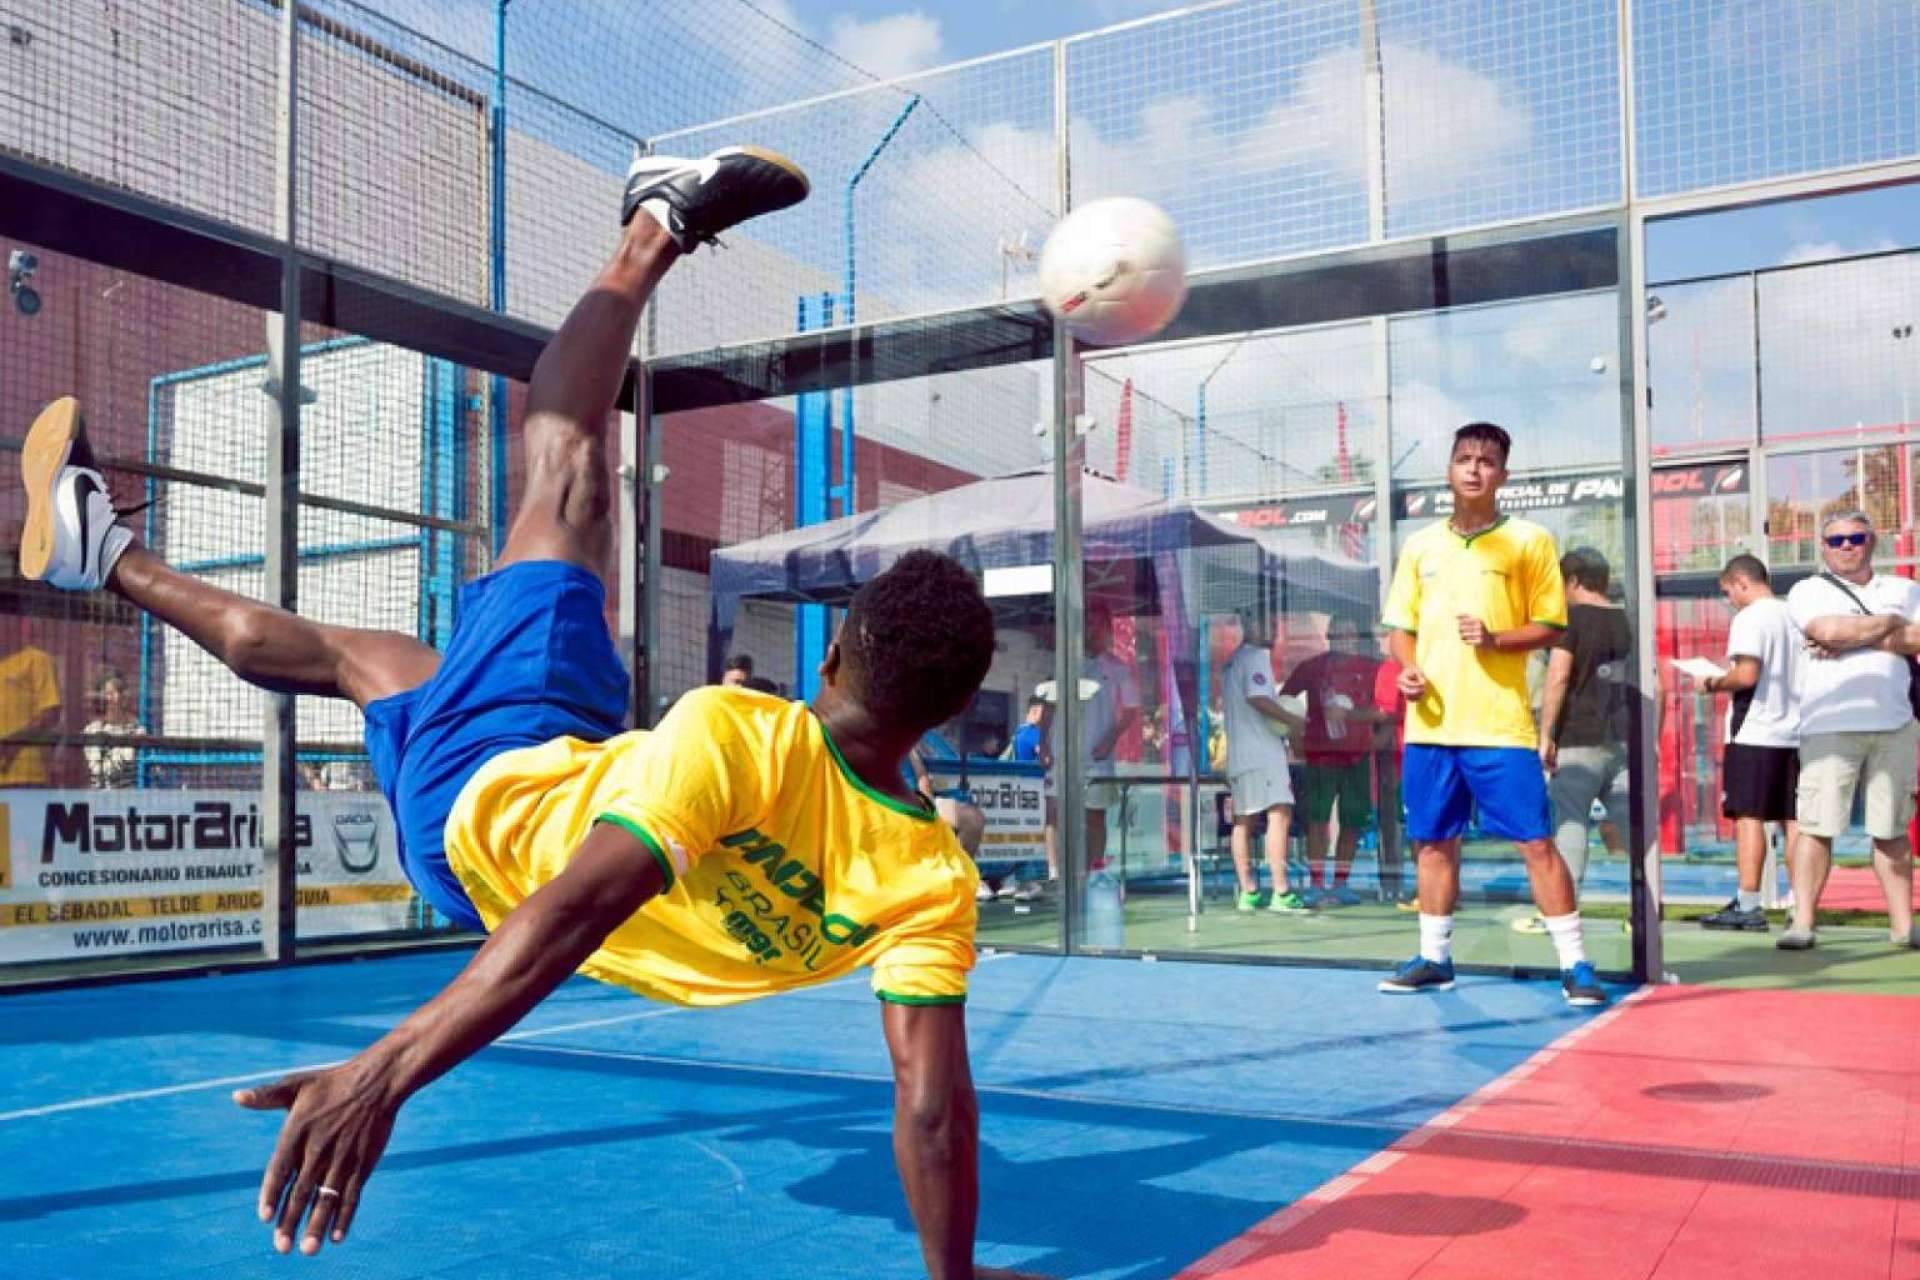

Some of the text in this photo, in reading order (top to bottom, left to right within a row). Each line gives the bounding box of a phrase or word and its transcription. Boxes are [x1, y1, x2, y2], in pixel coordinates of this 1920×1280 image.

[41, 802, 312, 864] MotorAria
[38, 866, 181, 888] CONCESIONARIO
[184, 863, 254, 881] RENAULT
[15, 904, 37, 924] EL
[152, 892, 201, 917] TELDE
[216, 889, 263, 913] ARUC
[725, 871, 822, 972] BRASIL
[73, 917, 263, 949] www.motorarisa.c
